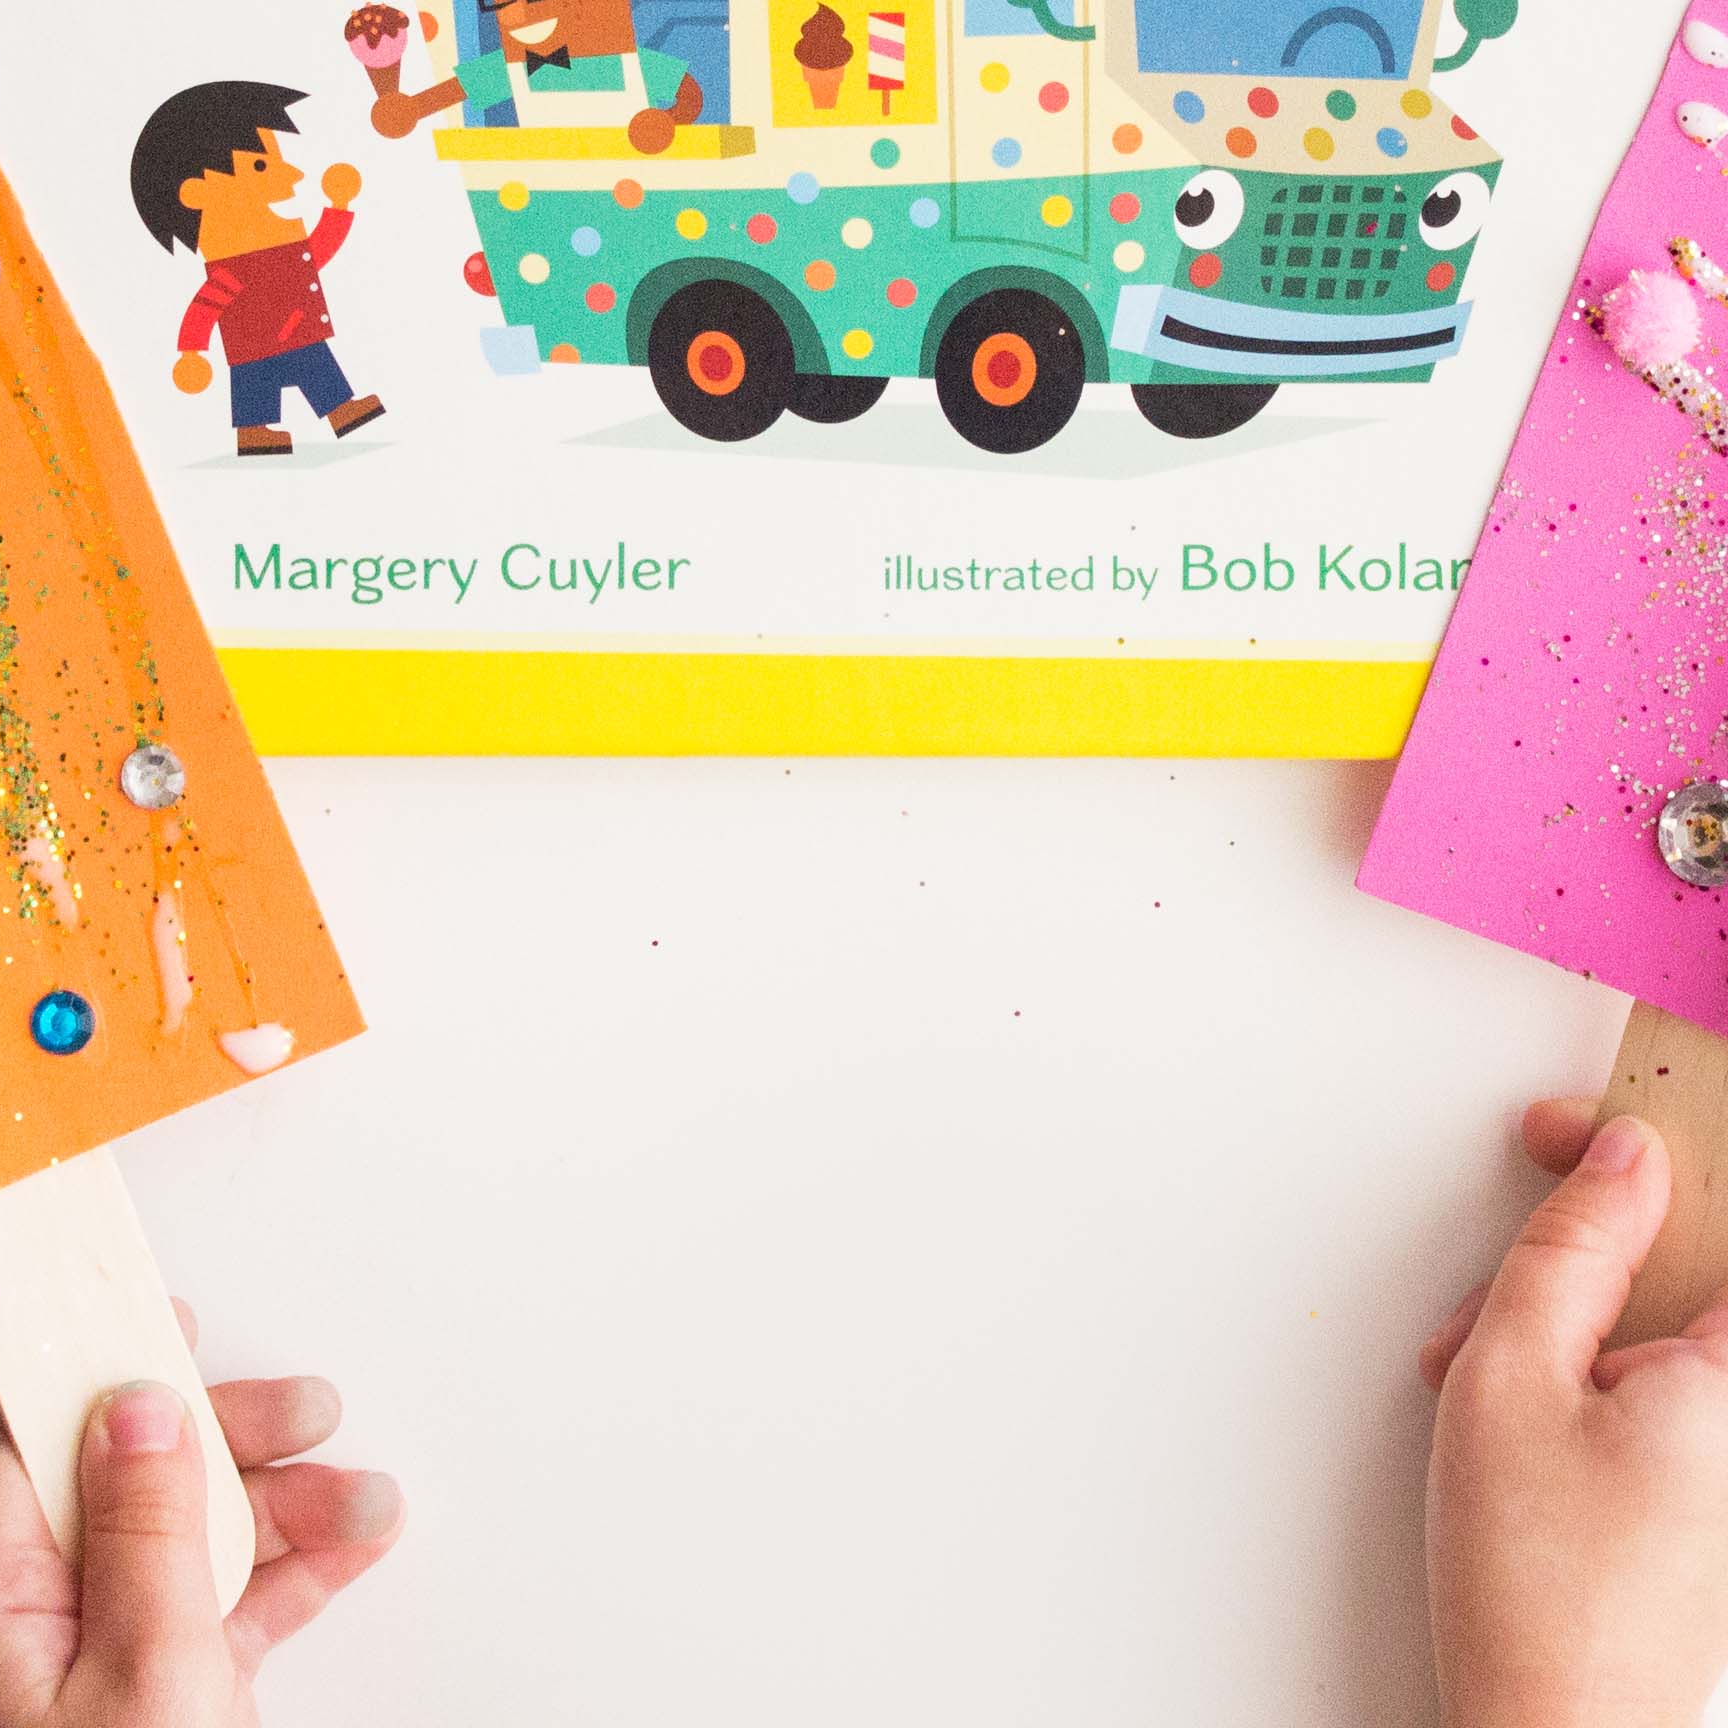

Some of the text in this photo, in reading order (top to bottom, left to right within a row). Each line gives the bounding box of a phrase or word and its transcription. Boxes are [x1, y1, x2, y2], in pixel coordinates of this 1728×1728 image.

[234, 543, 688, 605] Margery Cuyler
[883, 542, 1472, 603] illustrated by Bob Kolar
